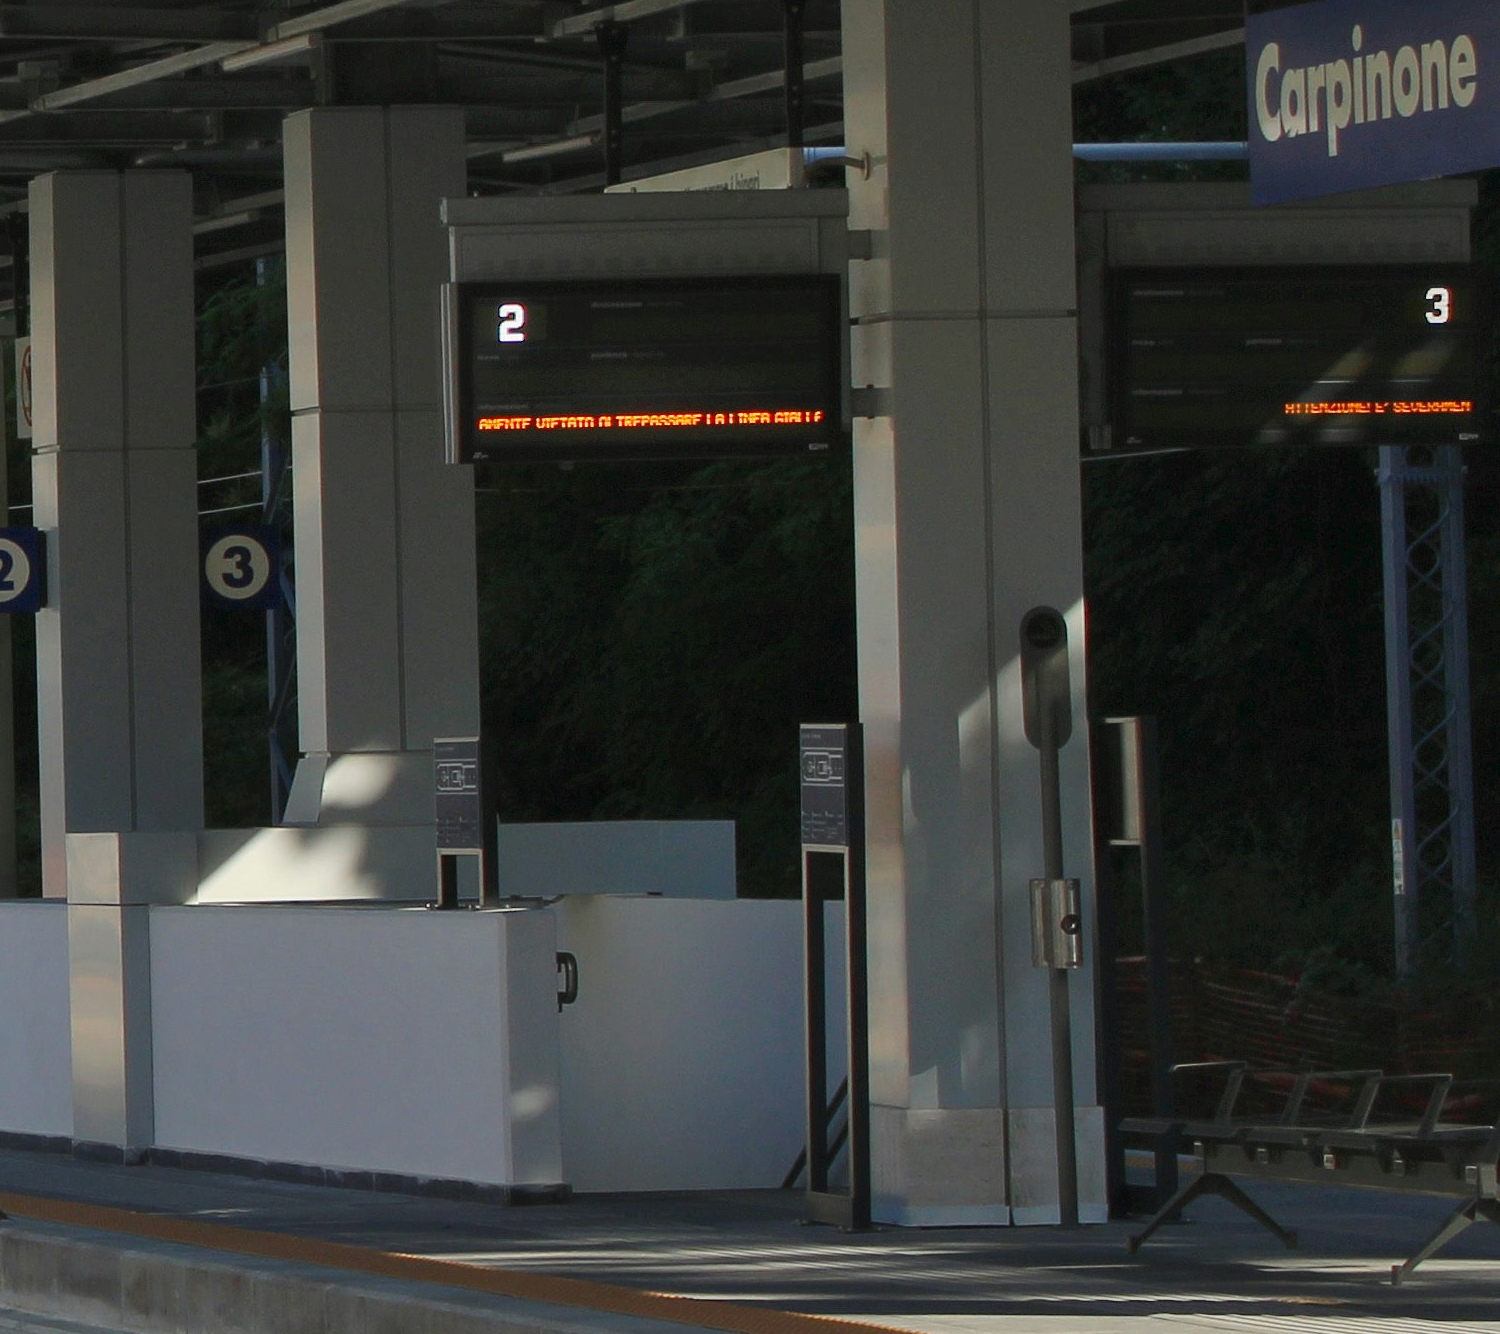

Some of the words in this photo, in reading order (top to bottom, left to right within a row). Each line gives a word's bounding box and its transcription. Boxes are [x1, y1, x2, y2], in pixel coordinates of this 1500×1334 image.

[1255, 24, 1477, 157] Carpinone
[497, 303, 526, 343] 2
[1425, 287, 1450, 324] 3
[536, 416, 594, 428] VIETATO
[222, 545, 255, 589] 3
